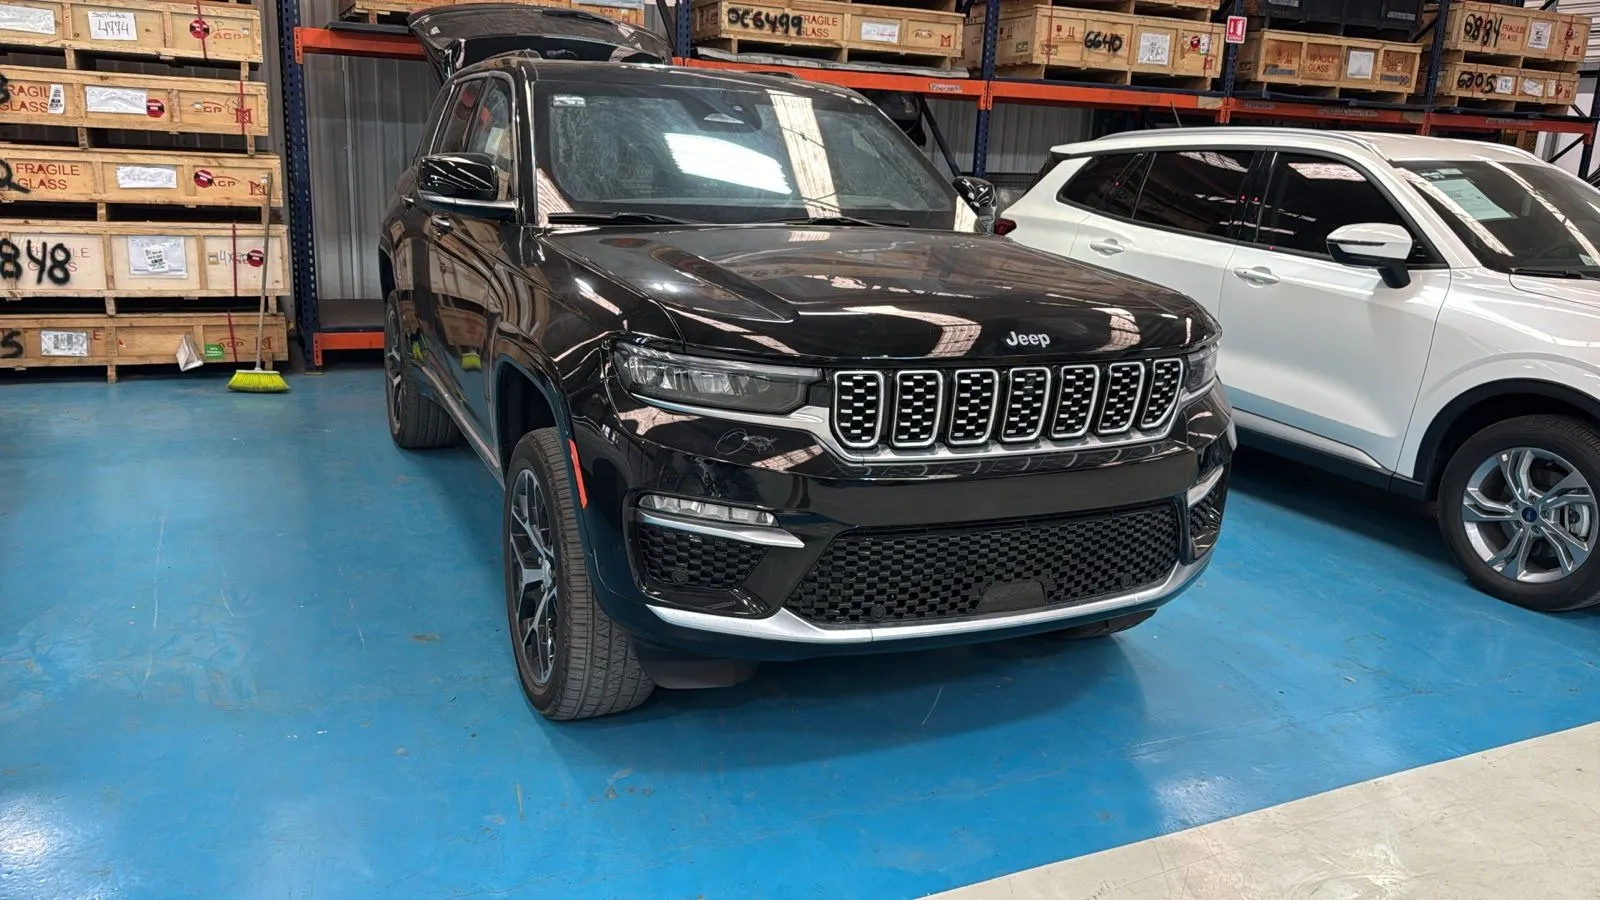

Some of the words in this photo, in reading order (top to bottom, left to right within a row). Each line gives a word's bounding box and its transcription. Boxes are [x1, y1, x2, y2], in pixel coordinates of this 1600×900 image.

[801, 14, 839, 26] FRAGILE
[7, 84, 50, 98] RAGIL
[15, 162, 81, 176] FRAGILE
[17, 177, 68, 190] GLASS
[1006, 330, 1051, 348] Jeep
